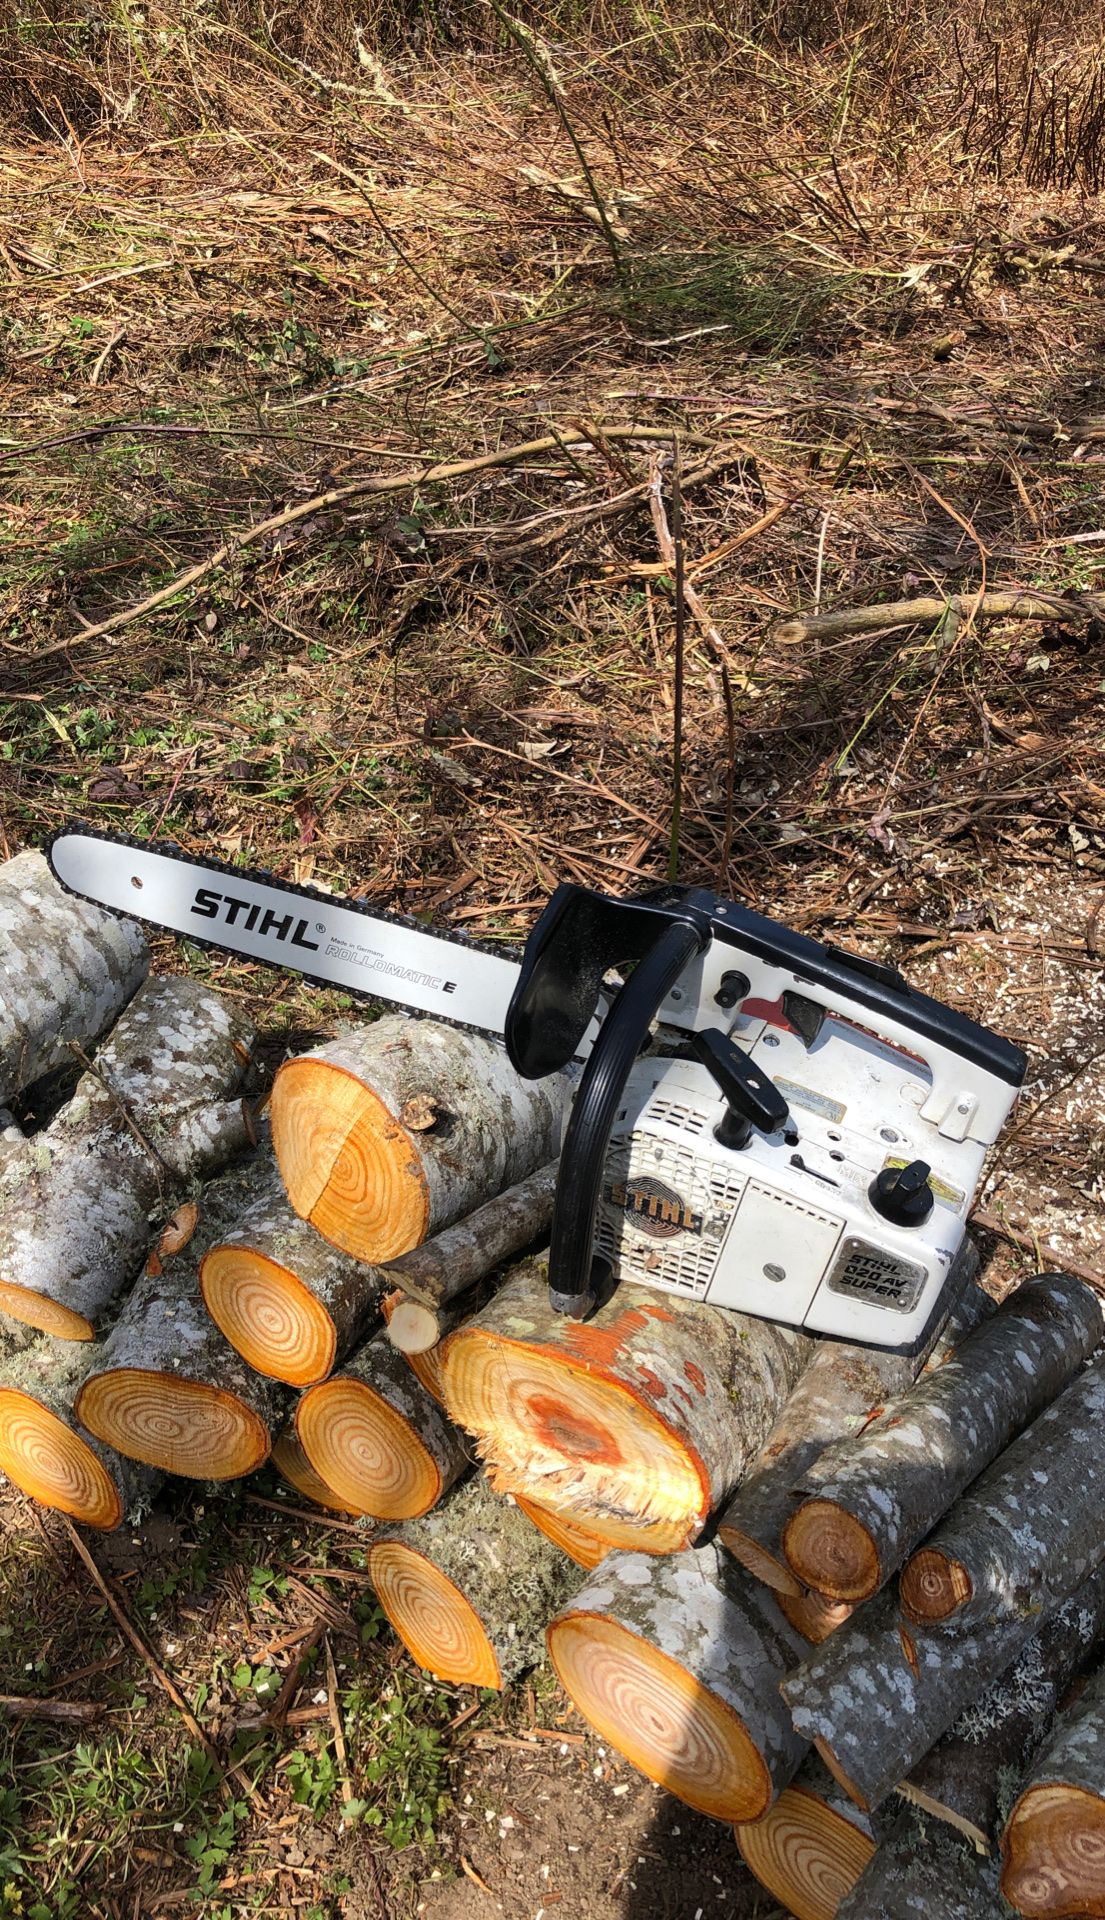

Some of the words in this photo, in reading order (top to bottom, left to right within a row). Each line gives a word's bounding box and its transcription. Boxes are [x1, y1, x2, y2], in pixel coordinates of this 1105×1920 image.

[330, 936, 348, 948] Made
[356, 943, 385, 958] Germany
[325, 944, 442, 990] ROLLOMATIC
[442, 981, 458, 994] E
[610, 1183, 695, 1230] STIHL
[848, 1254, 901, 1276] STIHL
[839, 1275, 901, 1298] SUPER
[883, 1277, 908, 1288] AV
